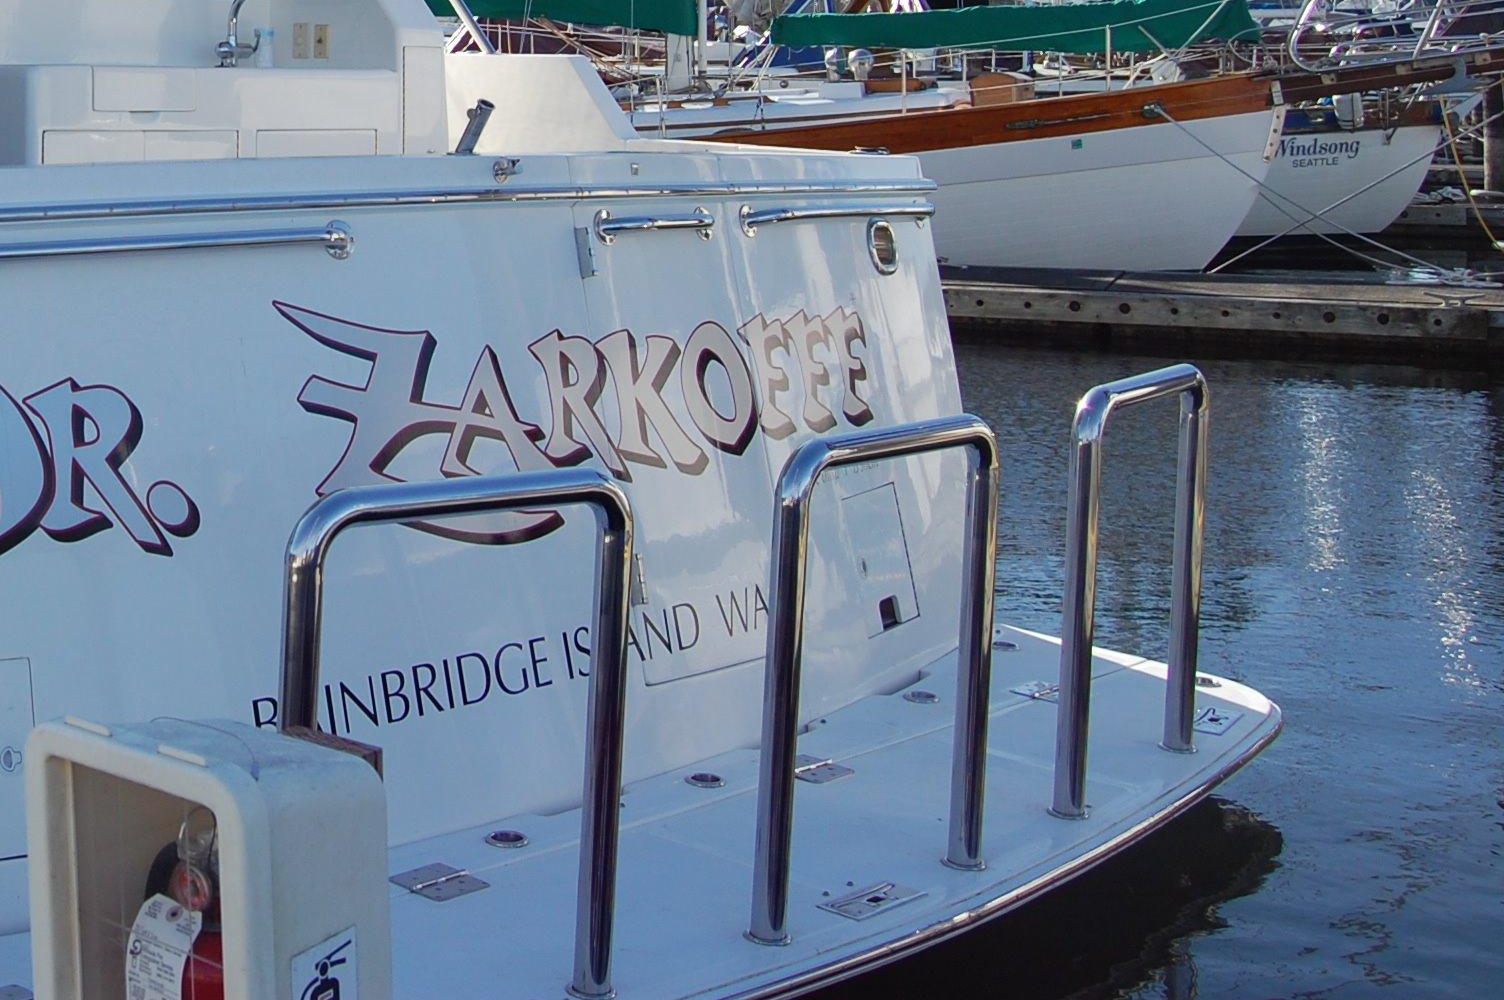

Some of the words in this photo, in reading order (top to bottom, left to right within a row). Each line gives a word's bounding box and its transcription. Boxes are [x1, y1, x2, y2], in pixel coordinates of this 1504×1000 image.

[1292, 157, 1339, 168] SEATTLE
[252, 637, 553, 736] BINBRIDGE
[562, 602, 700, 680] ISAND
